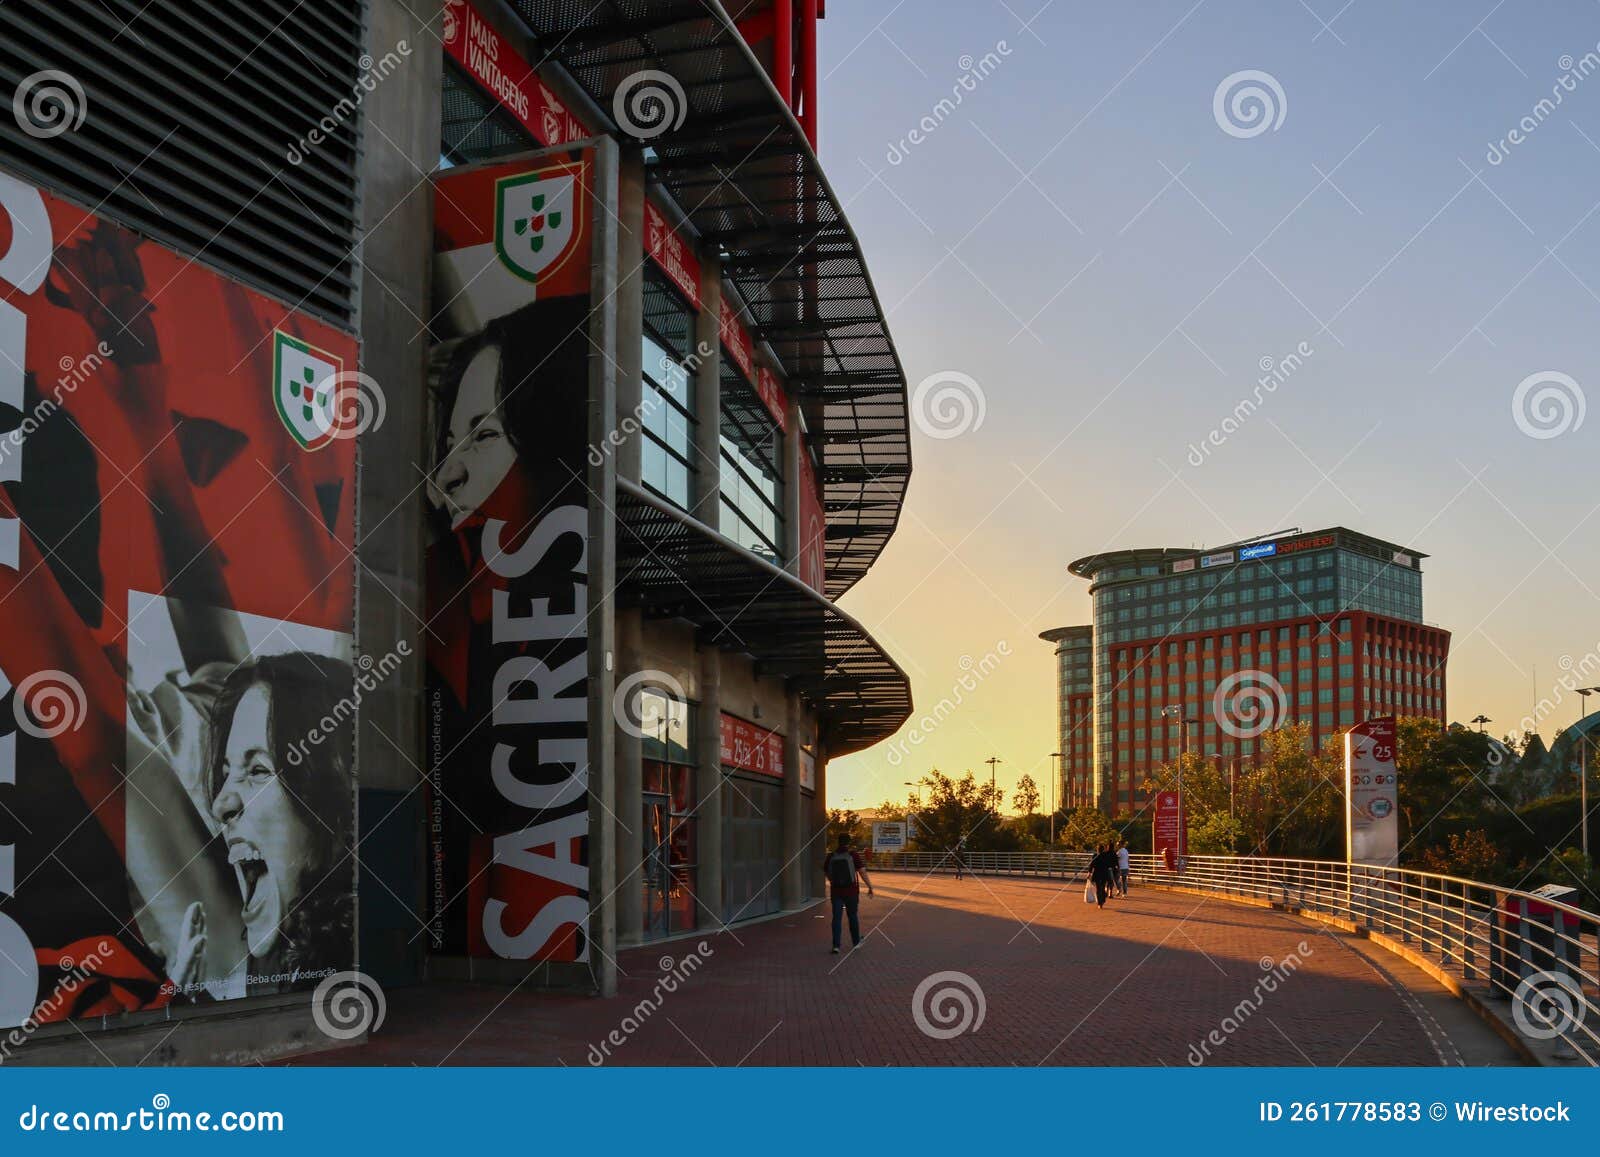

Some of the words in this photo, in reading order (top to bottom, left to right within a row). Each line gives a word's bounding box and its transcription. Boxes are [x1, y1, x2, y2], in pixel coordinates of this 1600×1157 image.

[470, 13, 498, 62] MAIS
[469, 45, 529, 121] VANTAGENS
[481, 505, 590, 963] SAGRES
[1375, 746, 1392, 758] 25
[433, 765, 442, 796] com
[431, 797, 442, 833] Beba
[160, 982, 183, 996] Seja
[247, 974, 269, 985] Beba
[271, 973, 290, 983] com
